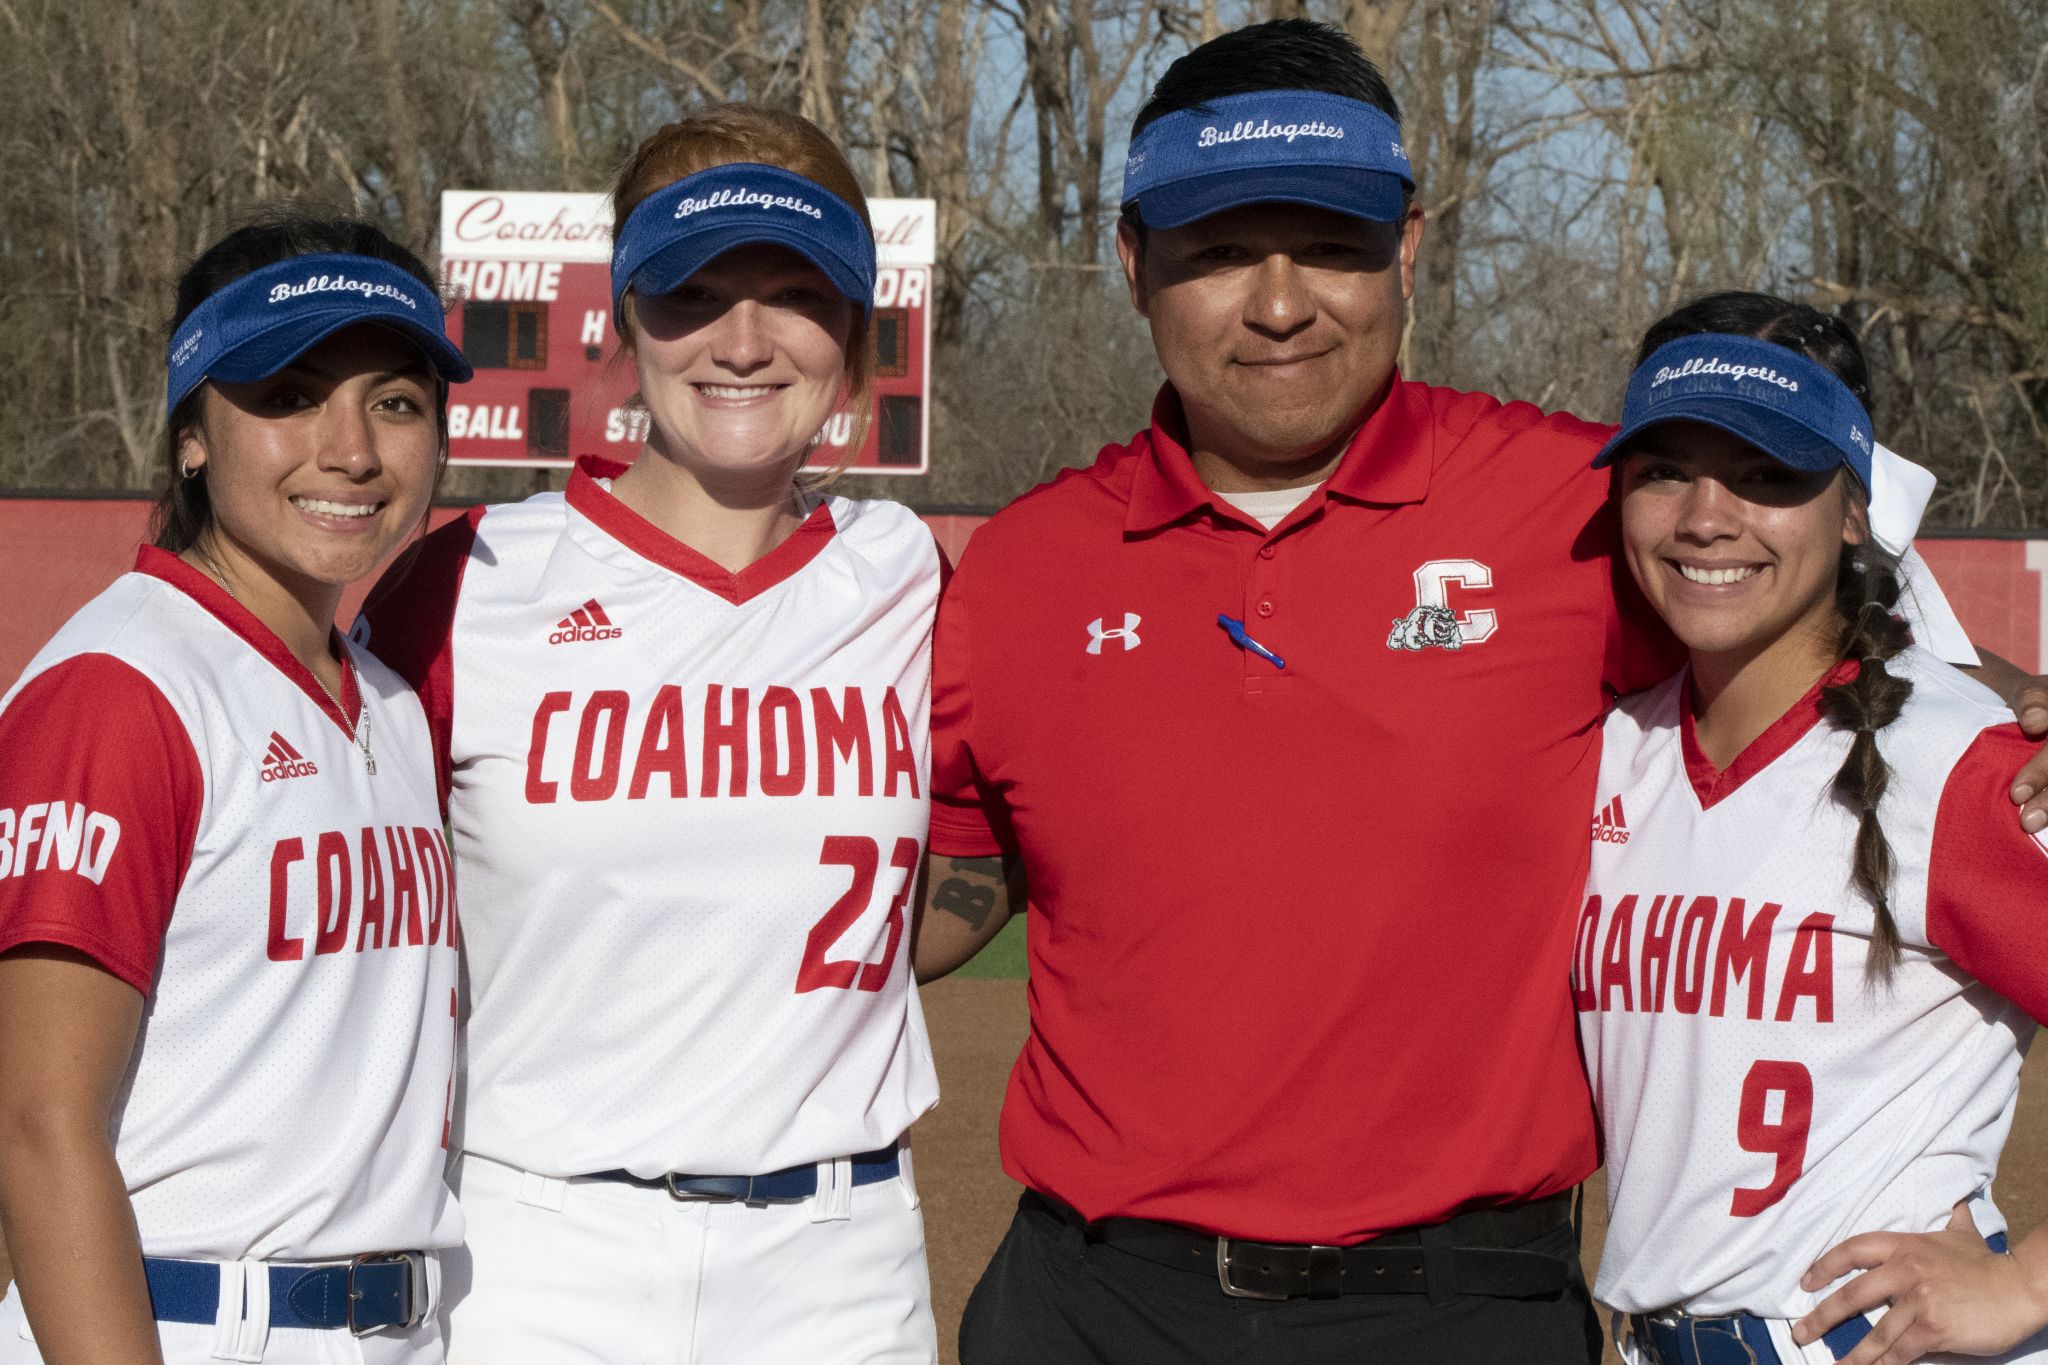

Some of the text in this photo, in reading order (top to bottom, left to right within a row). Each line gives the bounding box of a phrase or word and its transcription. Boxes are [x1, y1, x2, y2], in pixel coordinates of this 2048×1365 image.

[1197, 119, 1345, 147] Bulldogettes
[673, 187, 823, 220] Bulldogettes
[268, 275, 417, 310] Bulldogettes
[450, 260, 563, 302] HOME
[580, 310, 607, 344] H
[1650, 357, 1799, 392] Bulldogettes
[448, 404, 523, 440] BALL
[1412, 558, 1499, 644] C
[548, 625, 623, 645] adidas
[525, 684, 920, 804] COAHOMA
[260, 757, 319, 783] adidas
[1591, 824, 1630, 844] didas
[794, 835, 920, 994] 23
[1573, 894, 1836, 1024] OAHOMA
[1729, 1059, 1814, 1218] 9
